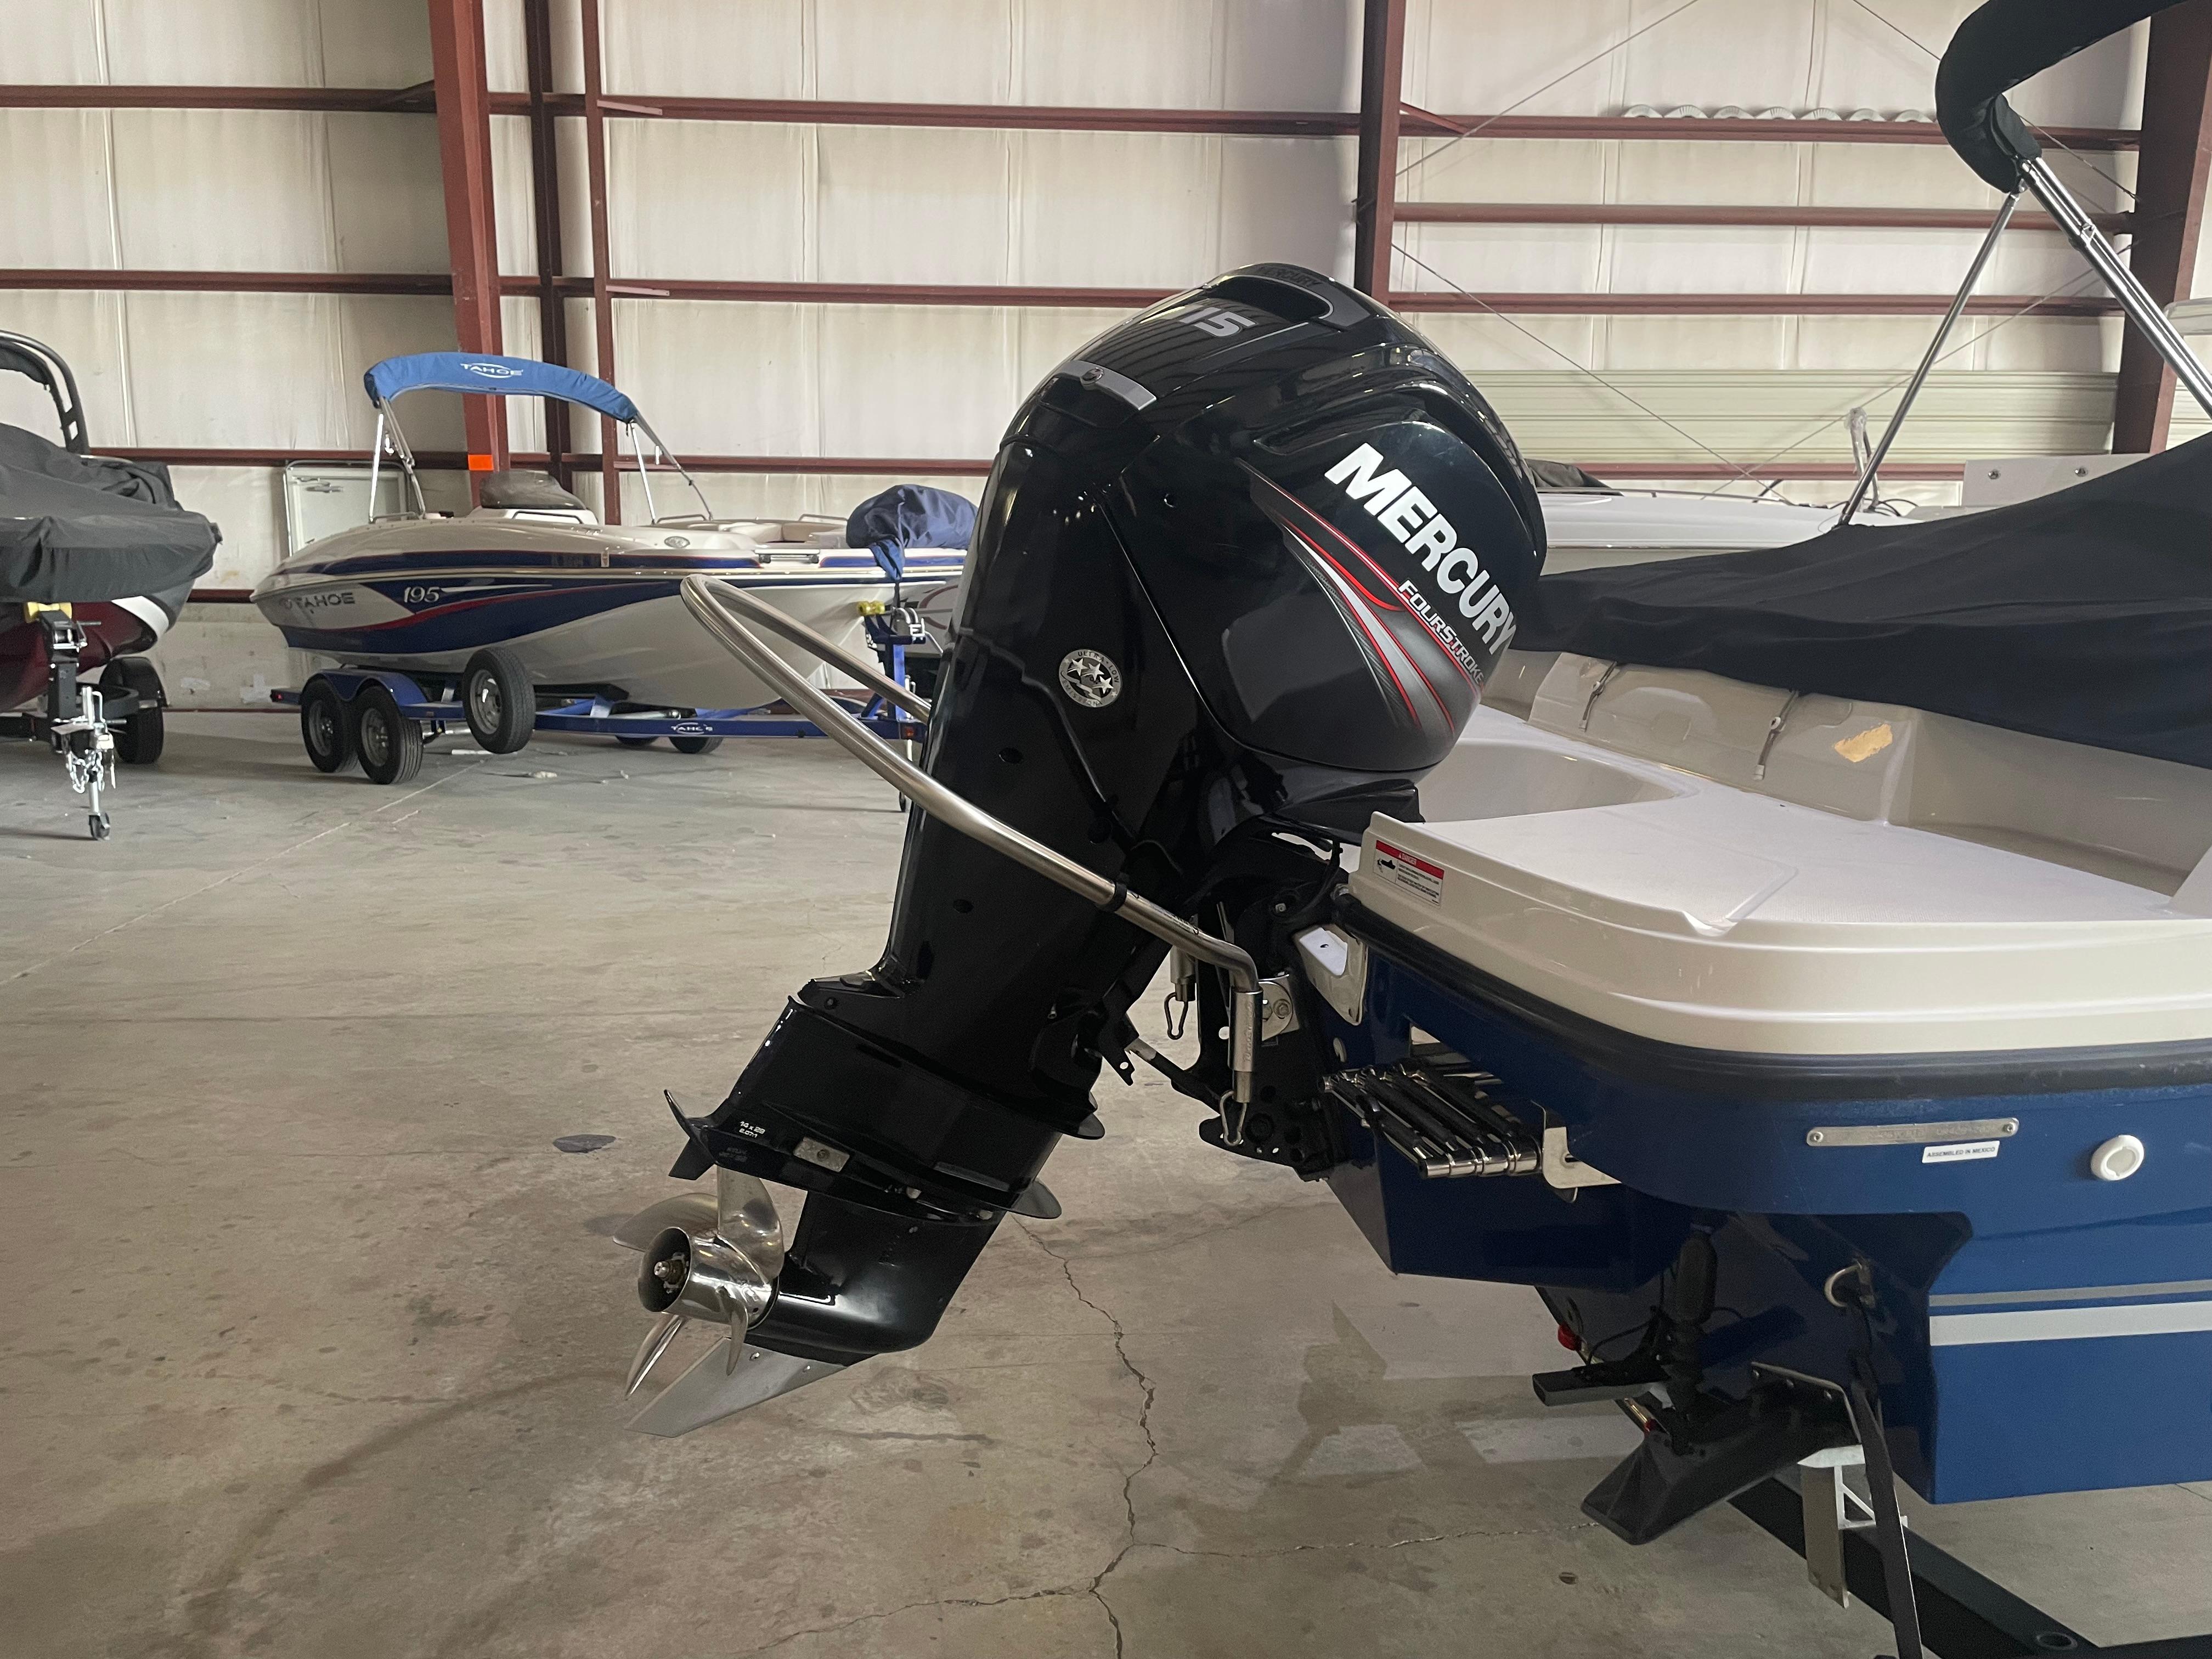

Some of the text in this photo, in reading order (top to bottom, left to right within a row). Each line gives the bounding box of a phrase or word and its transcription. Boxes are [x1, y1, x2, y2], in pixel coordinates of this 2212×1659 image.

[459, 363, 524, 376] TAHOE
[1324, 442, 1516, 655] MERCURY
[295, 592, 356, 610] TAHOE
[403, 586, 441, 603] 195
[1077, 651, 1105, 662] ULTRA
[1108, 665, 1120, 683] LOW
